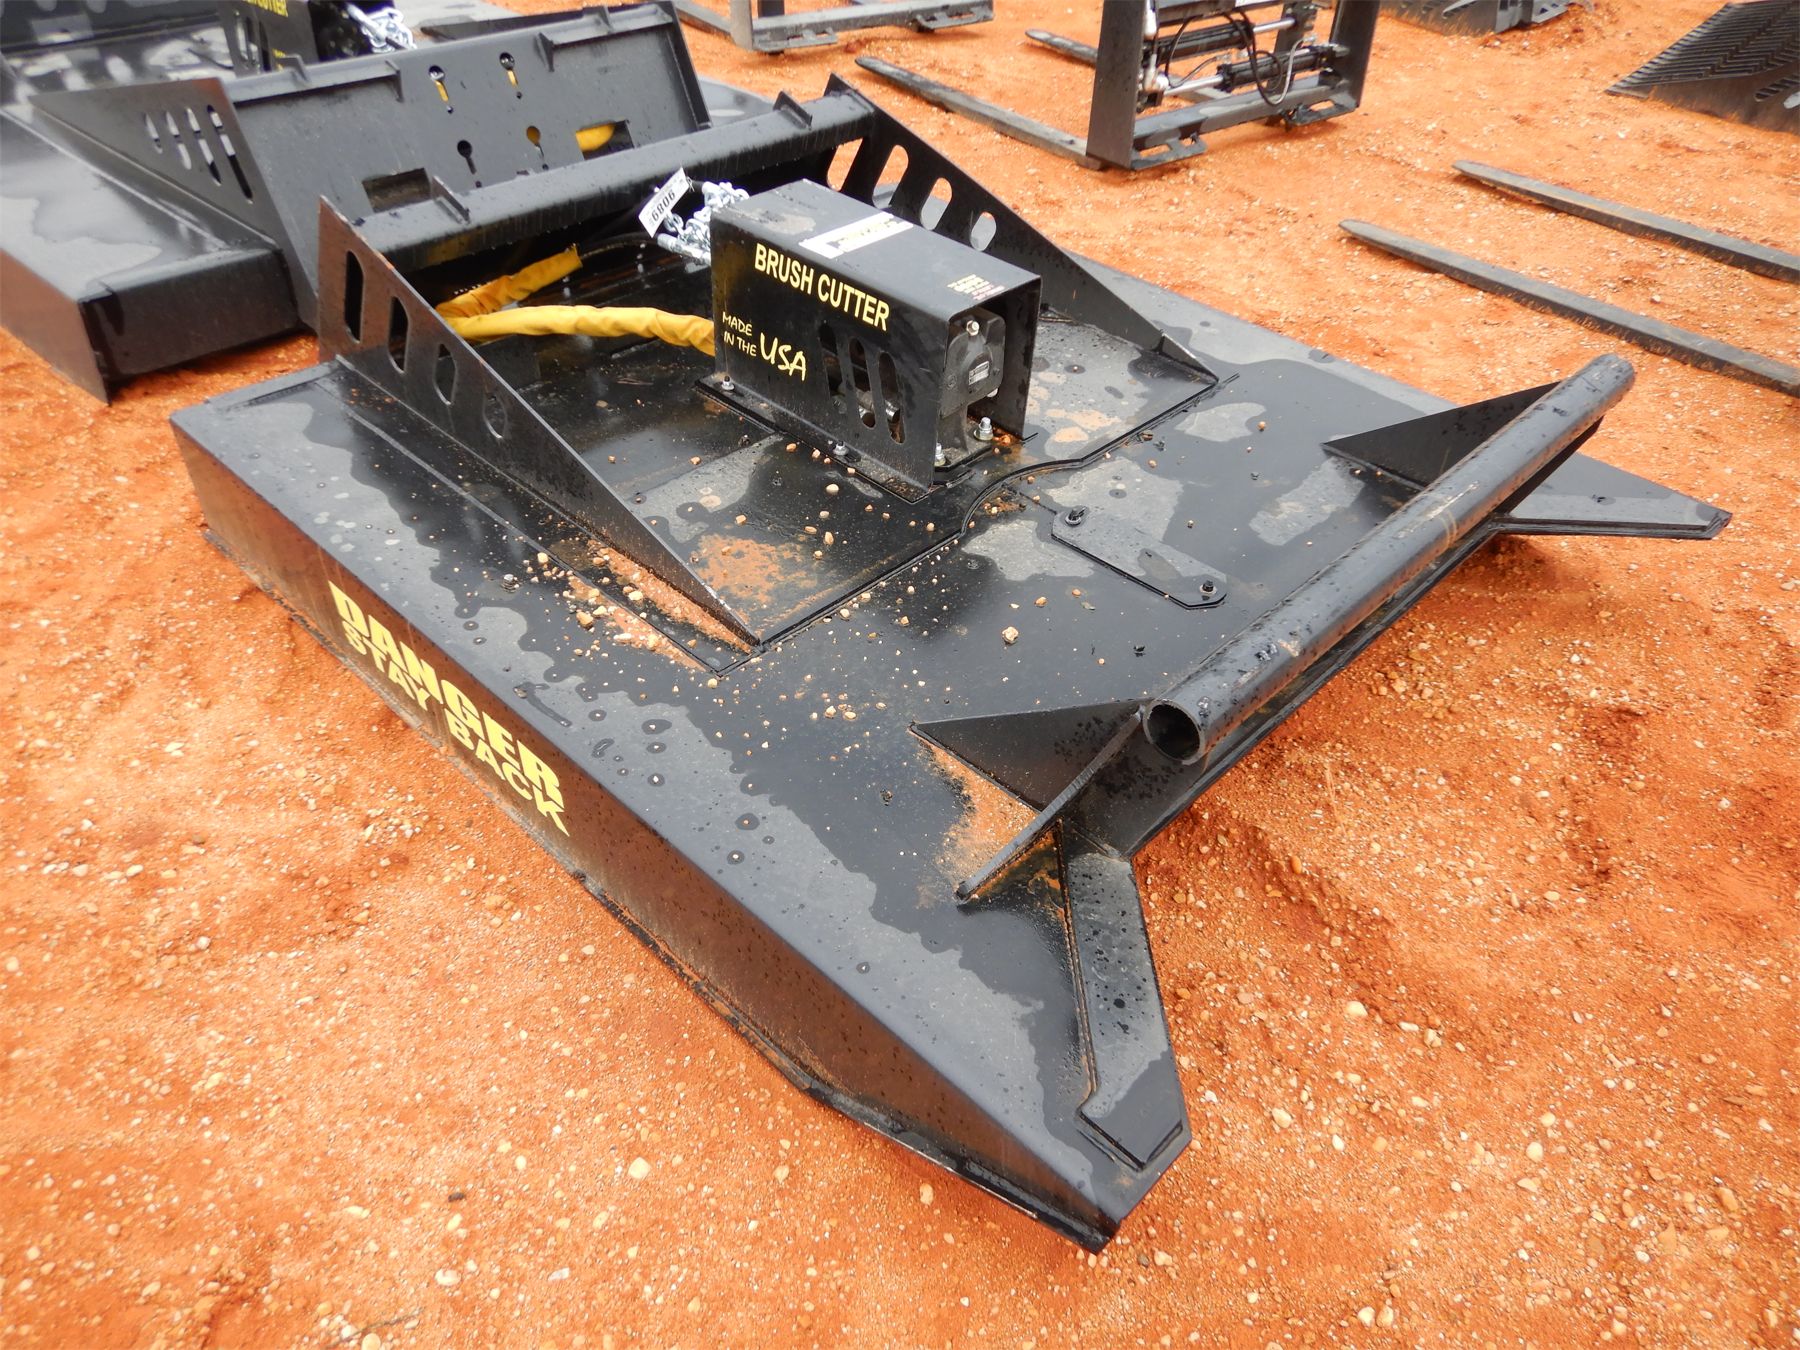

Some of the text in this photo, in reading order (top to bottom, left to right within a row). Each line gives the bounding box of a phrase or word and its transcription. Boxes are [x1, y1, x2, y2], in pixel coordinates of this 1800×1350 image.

[722, 311, 753, 337] MADE
[755, 243, 814, 295] BRUSH
[818, 274, 890, 332] CUTTER
[724, 331, 807, 381] IN THE USA
[328, 580, 565, 809] DANGER
[342, 620, 570, 837] STAY BACK
